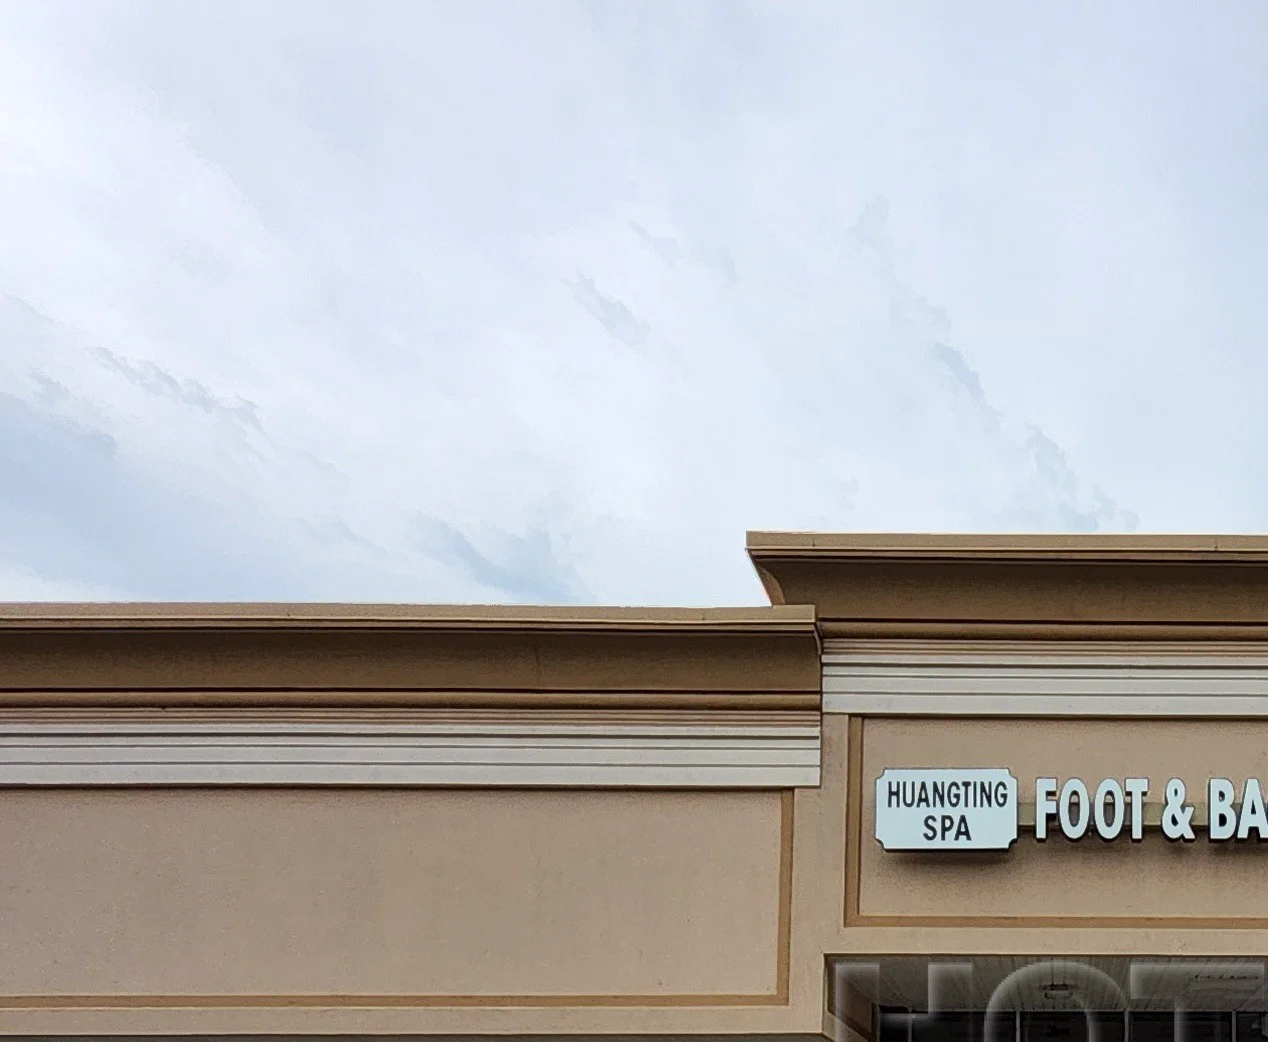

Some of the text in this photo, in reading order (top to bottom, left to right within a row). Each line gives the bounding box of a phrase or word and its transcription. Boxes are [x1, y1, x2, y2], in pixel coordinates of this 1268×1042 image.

[886, 780, 1009, 809] HUANGTING
[1035, 777, 1149, 842] FOOT
[1161, 777, 1196, 842] &
[922, 813, 972, 842] SPA
